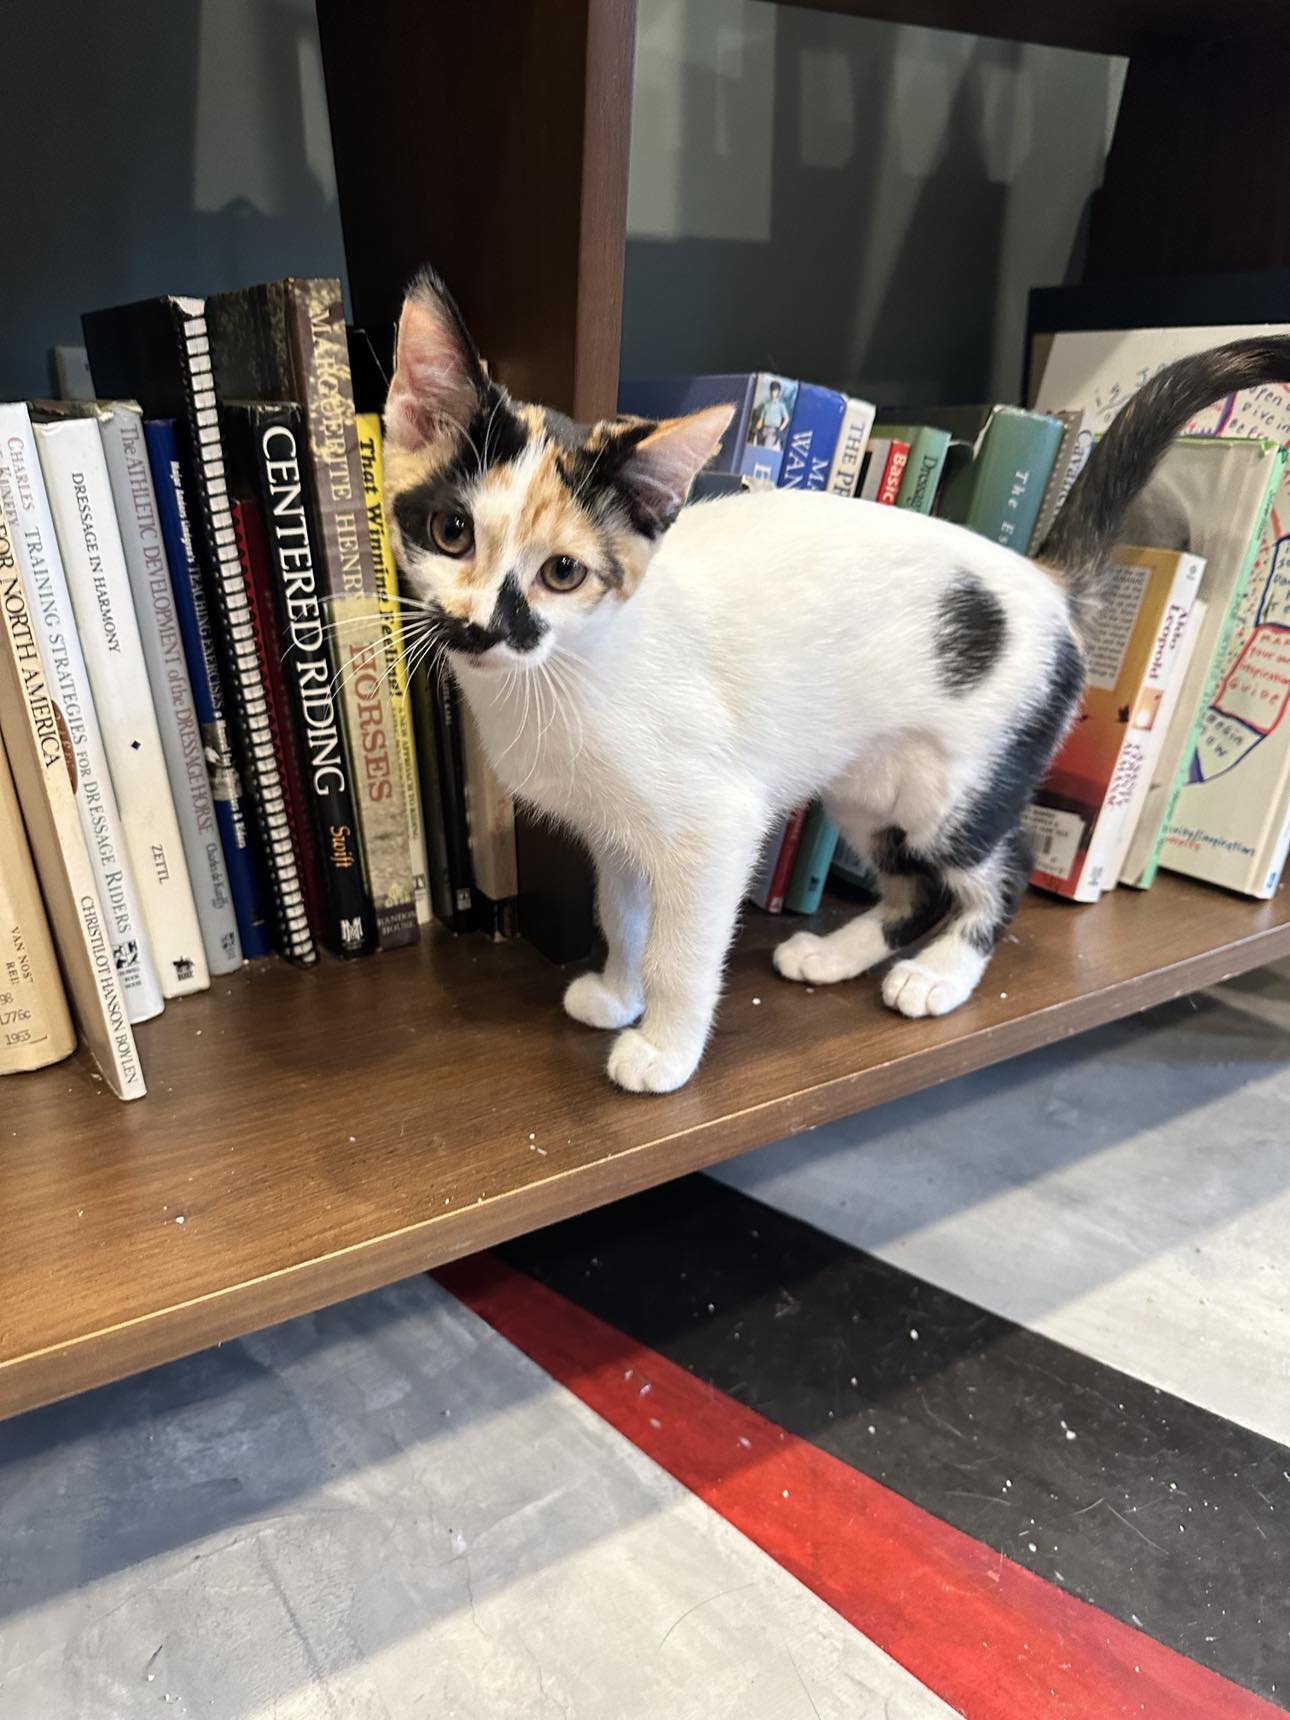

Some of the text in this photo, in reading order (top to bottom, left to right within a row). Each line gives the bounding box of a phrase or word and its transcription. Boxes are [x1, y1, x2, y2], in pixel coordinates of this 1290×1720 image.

[120, 422, 141, 458] The
[309, 304, 352, 501] MARGUERITE
[8, 435, 35, 512] CHARLES
[360, 437, 379, 496] That
[841, 422, 864, 465] THE
[882, 452, 907, 506] Basic
[127, 456, 158, 540] ATHLETIC
[1008, 468, 1030, 510] The
[25, 525, 60, 627] TRAINING
[72, 471, 121, 654] DRESSAGE IN HARMONY
[367, 502, 389, 604] Winning
[143, 545, 182, 665] DEVELOPMENT
[188, 563, 212, 637] TEACHING
[202, 637, 225, 710] EXERCISES
[1149, 604, 1183, 680] Leopold
[1168, 609, 1188, 650] Aldo
[168, 668, 186, 685] of
[262, 424, 355, 869] CENTERED RIDING Swift
[49, 632, 88, 746] STRATEGIES
[170, 684, 188, 706] the
[349, 642, 394, 802] HORSES
[76, 750, 92, 778] FOR
[175, 705, 204, 785] DRESSAGE
[1, 577, 38, 661] NORTH
[21, 667, 61, 768] AMERICA
[80, 895, 112, 976] CHRISTILOT
[100, 975, 126, 1033] HANSON
[114, 1032, 139, 1086] BOYLEN
[83, 779, 117, 867] DRESSAGE
[191, 785, 214, 835] HORSE
[104, 868, 132, 935] RIDERS
[151, 844, 170, 884] ZETTL
[11, 925, 25, 952] VAN
[5, 1029, 32, 1046] 1963
